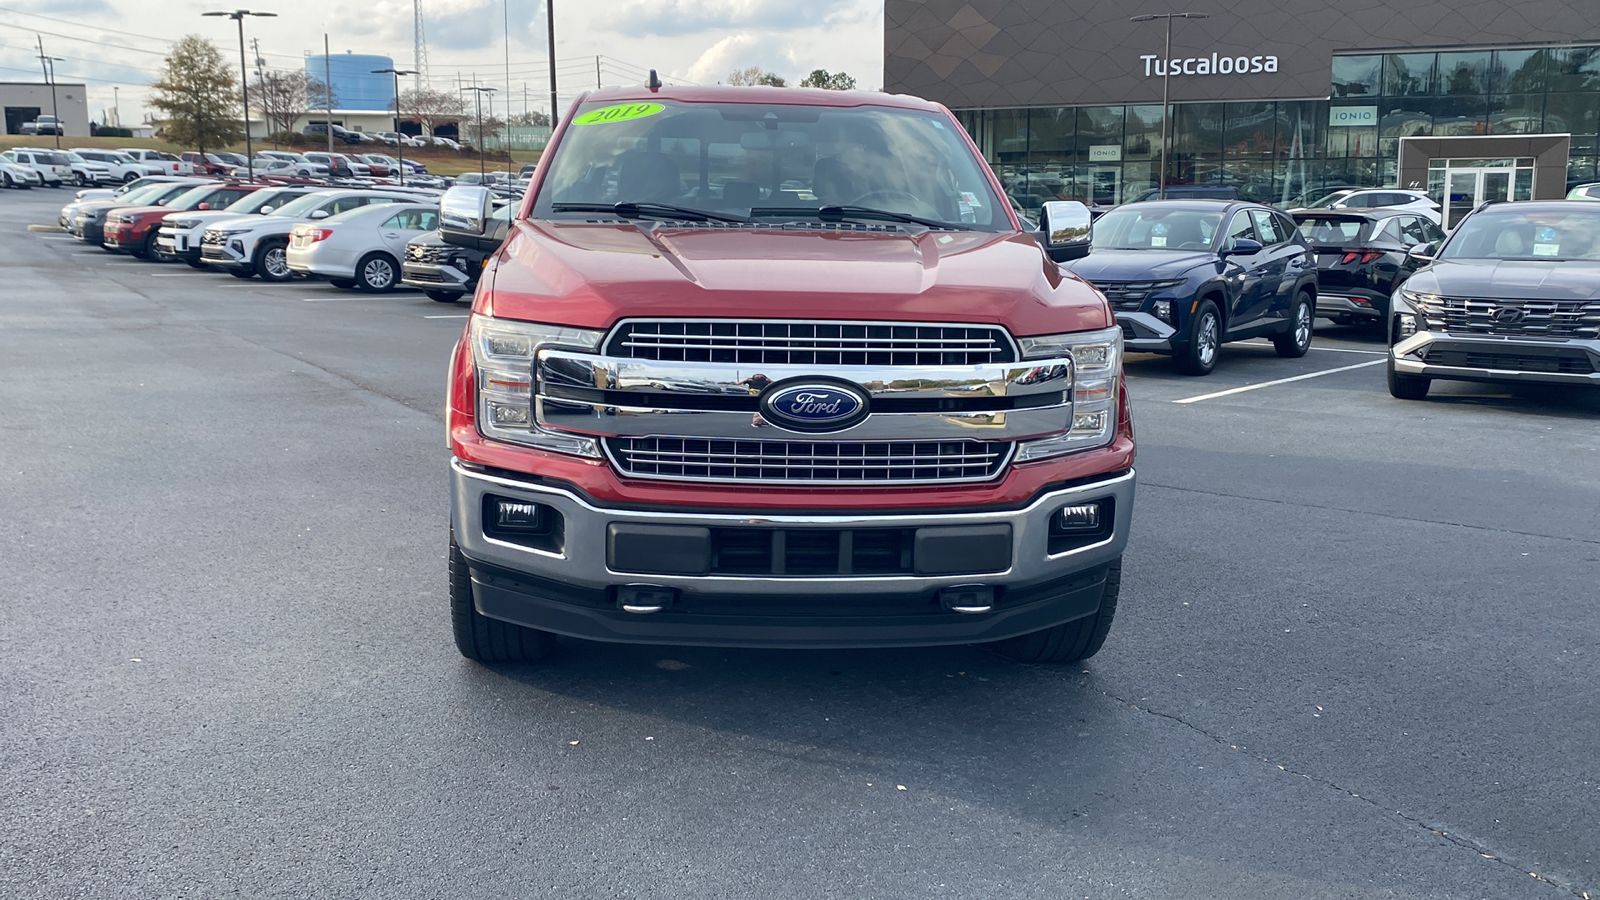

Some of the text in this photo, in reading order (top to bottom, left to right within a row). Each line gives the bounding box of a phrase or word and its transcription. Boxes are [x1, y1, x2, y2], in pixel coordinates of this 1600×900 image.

[1140, 52, 1278, 77] Tuscaloosa
[587, 104, 651, 123] 2019
[790, 392, 841, 414] Ford
